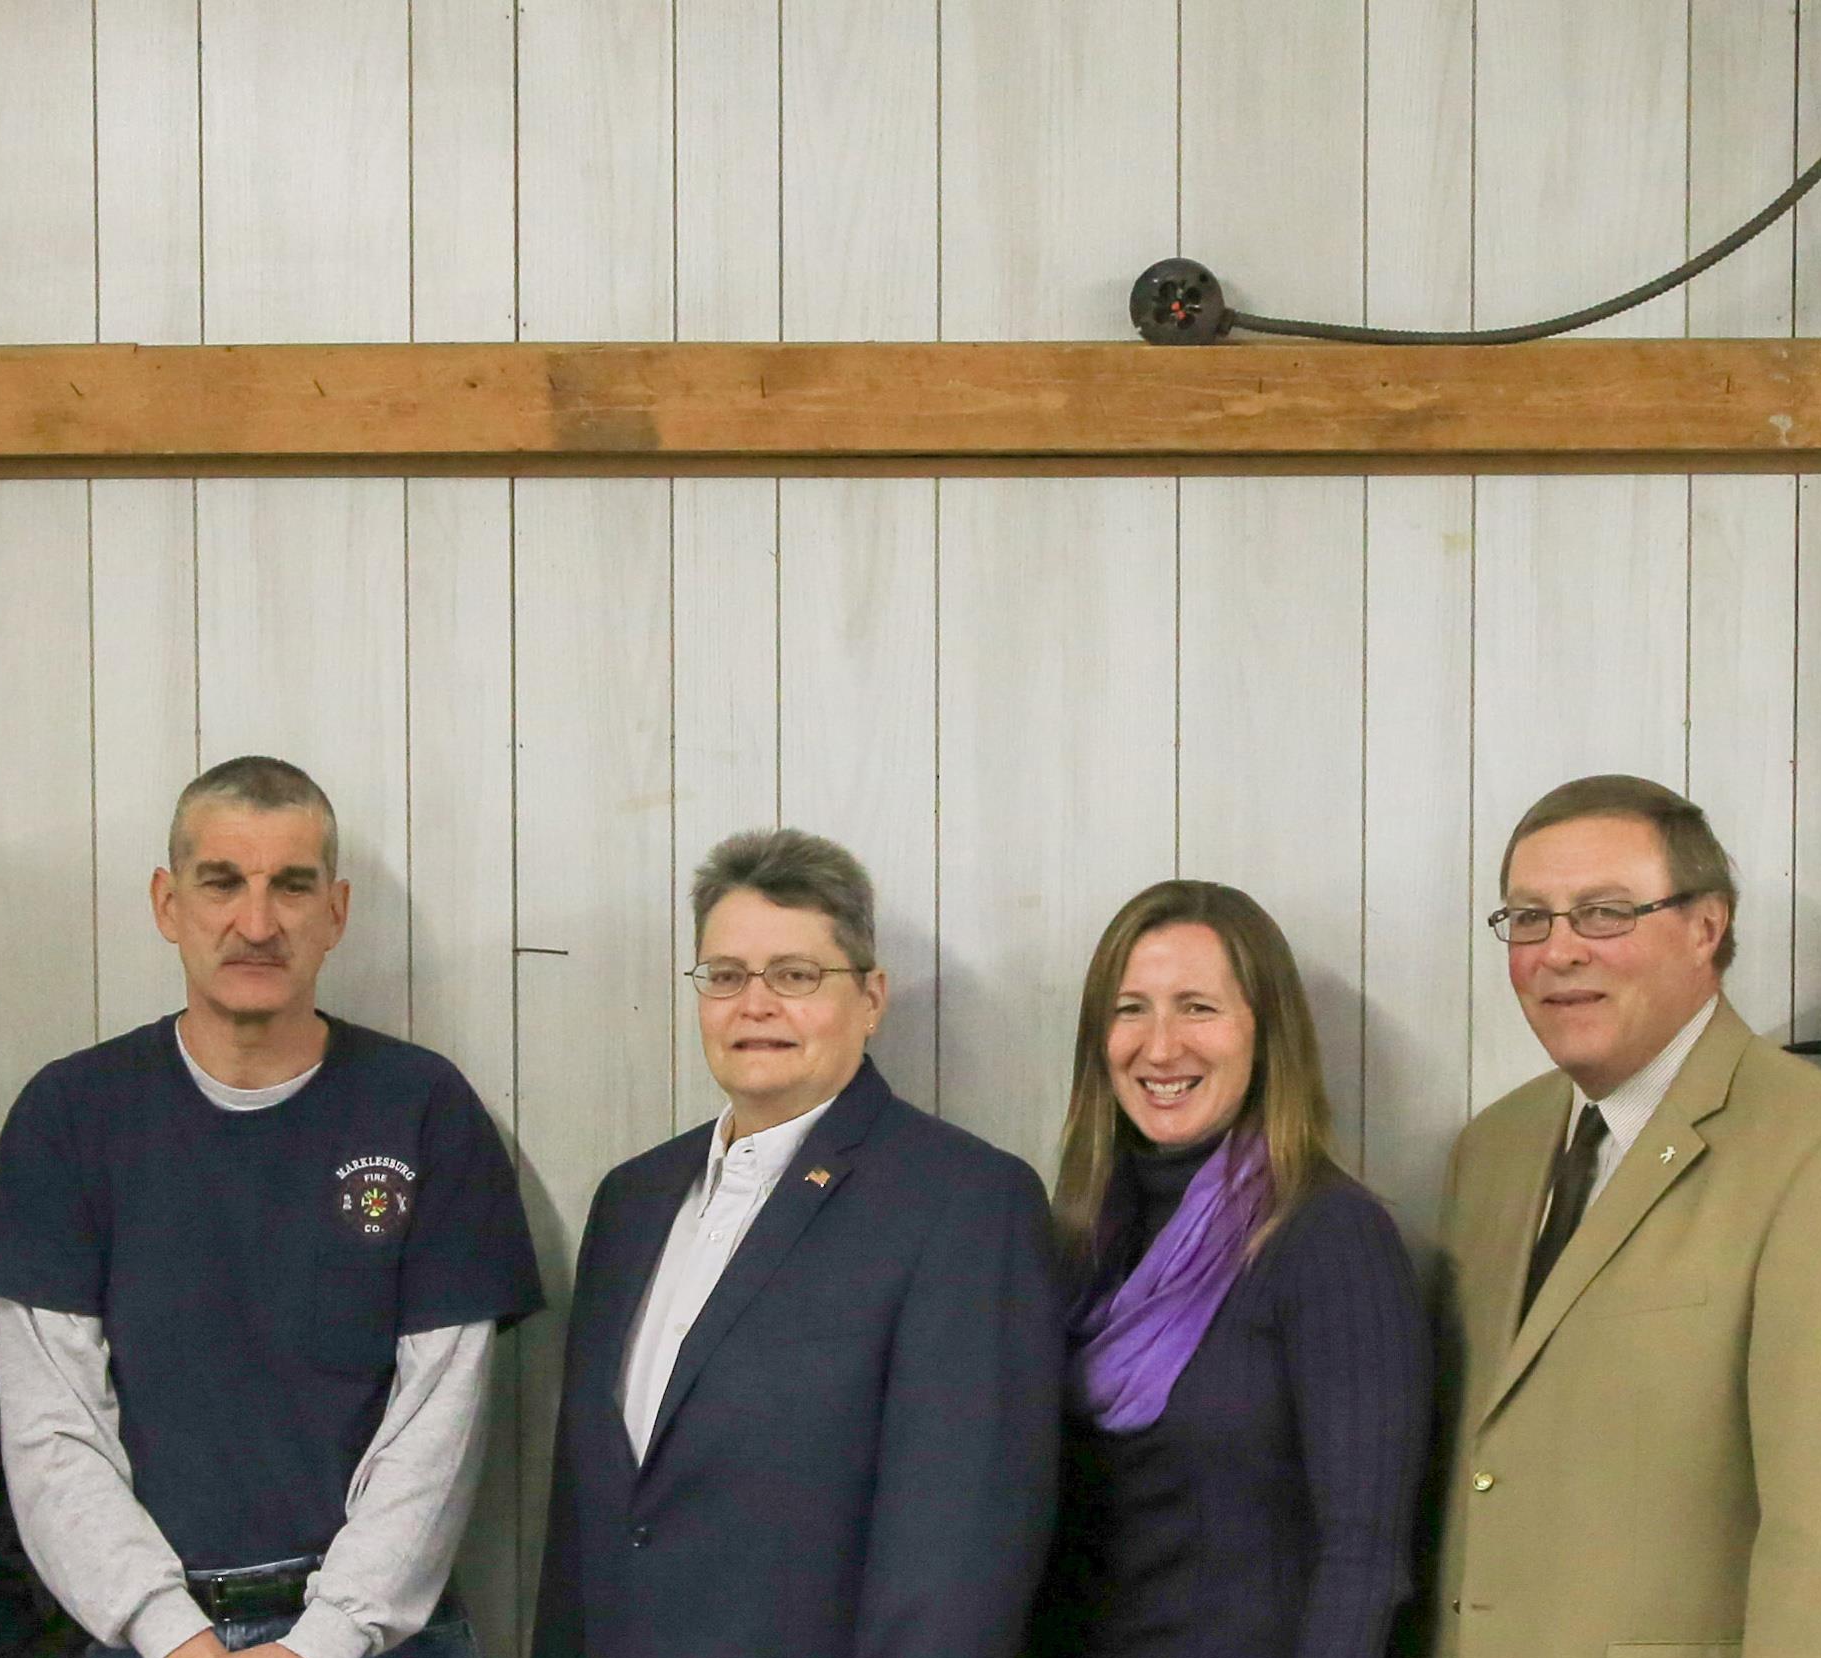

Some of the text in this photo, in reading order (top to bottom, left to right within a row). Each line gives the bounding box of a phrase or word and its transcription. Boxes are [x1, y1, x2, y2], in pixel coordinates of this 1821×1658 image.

[335, 1156, 416, 1181] MARKLESBURG
[364, 1173, 388, 1183] FIRE
[364, 1224, 385, 1233] CO.
